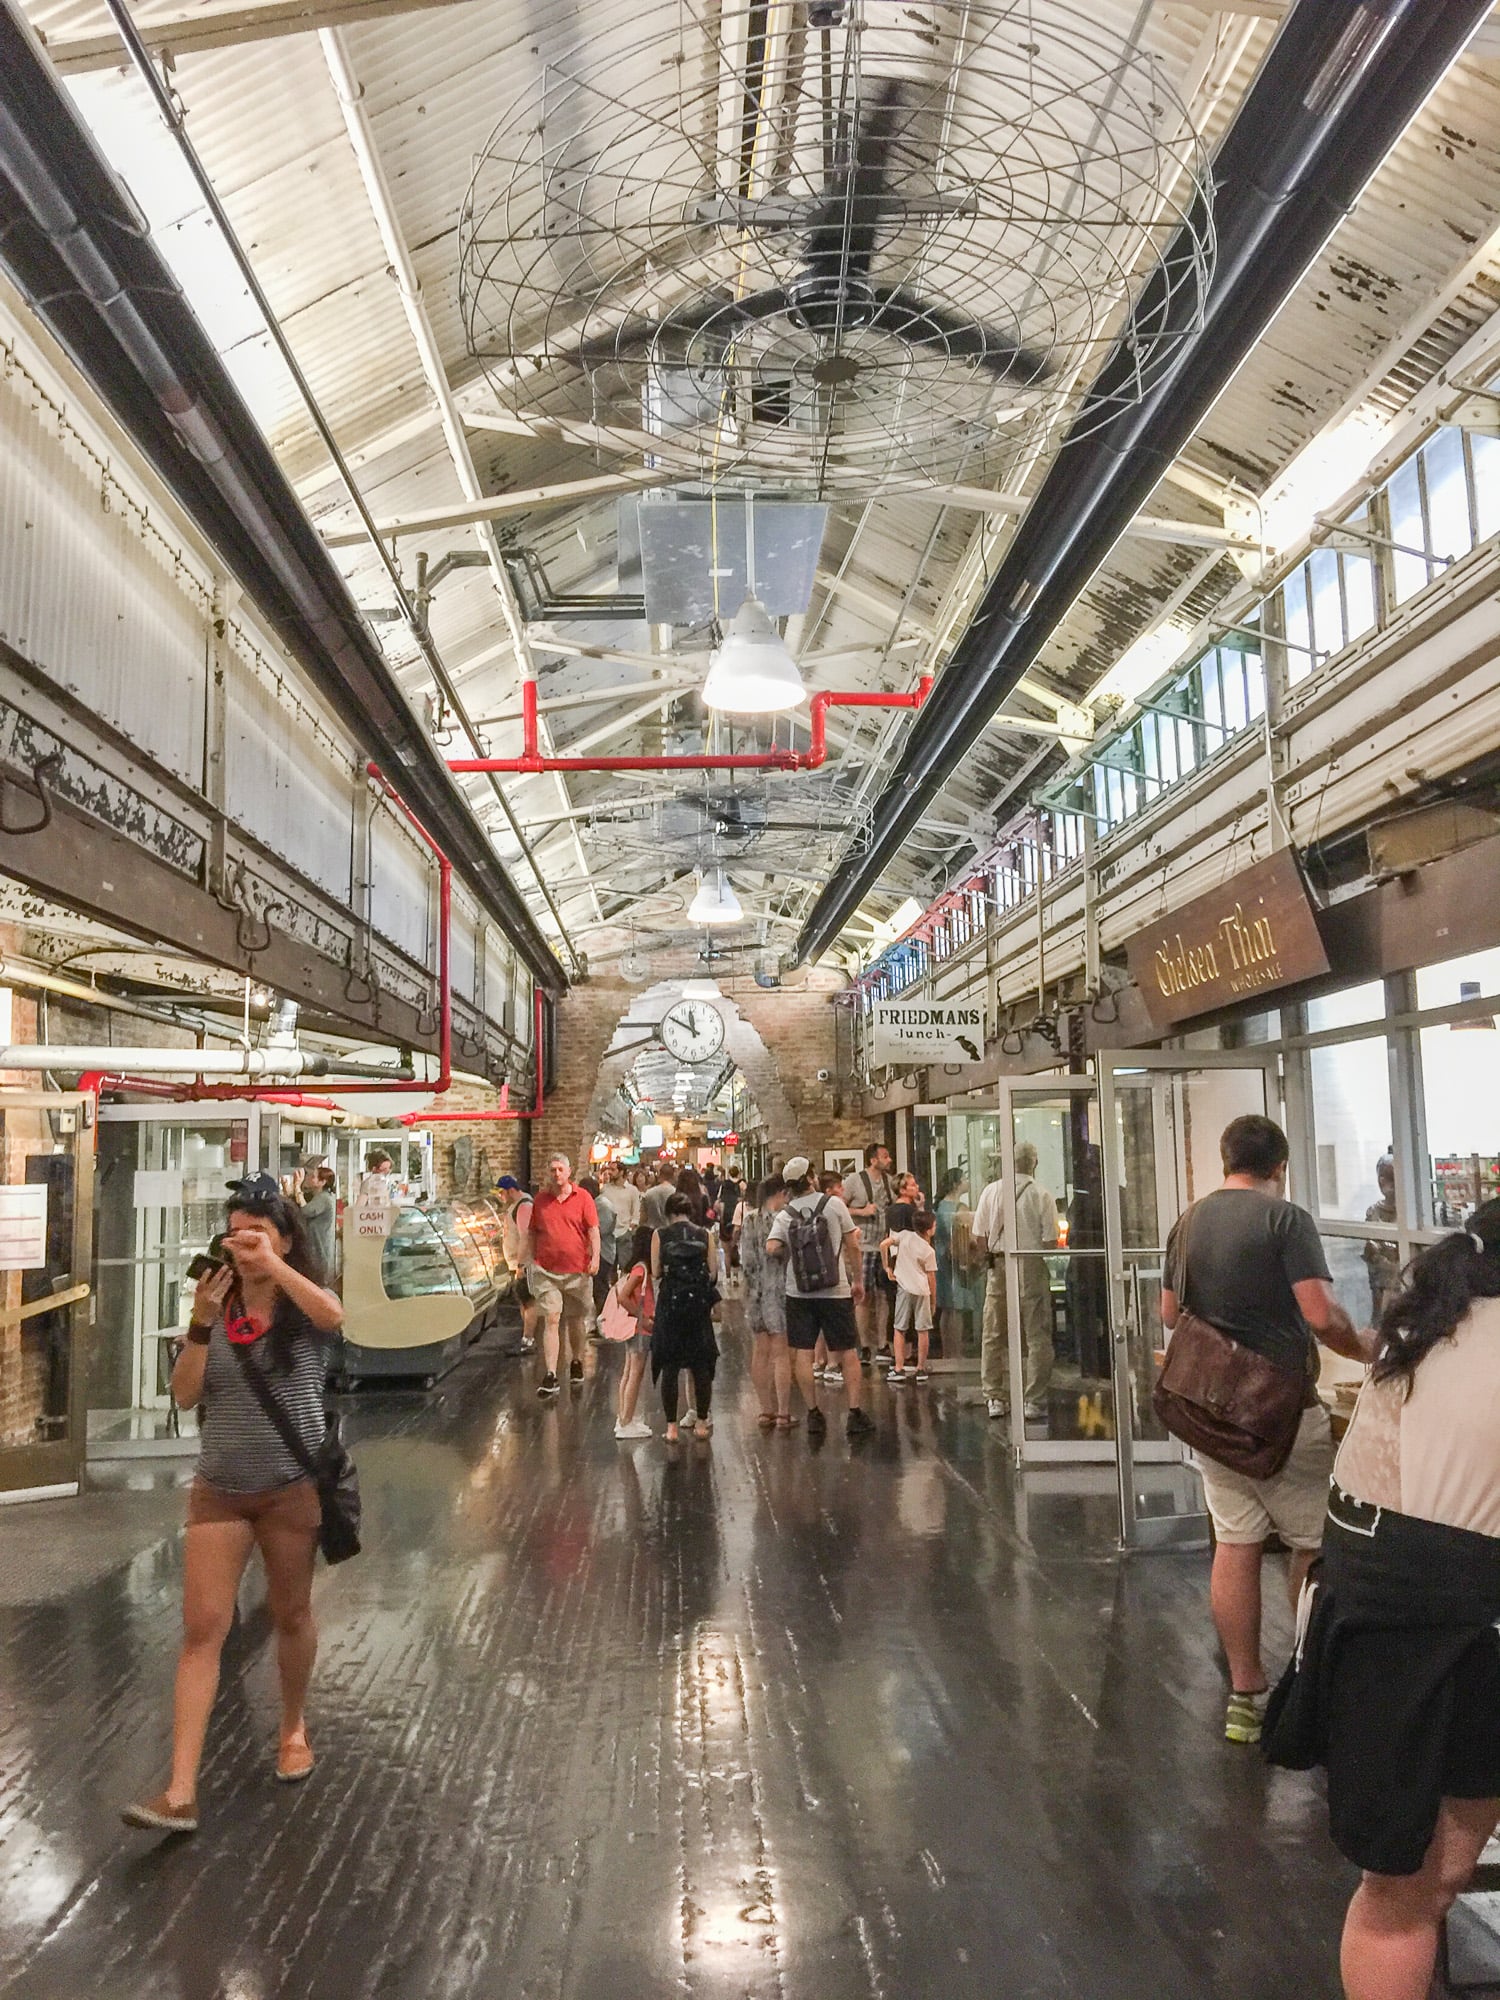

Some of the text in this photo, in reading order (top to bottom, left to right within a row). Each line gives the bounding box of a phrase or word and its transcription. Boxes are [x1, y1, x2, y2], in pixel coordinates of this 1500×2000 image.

[1155, 896, 1277, 997] Chelsea Thai
[709, 1015, 715, 1023] 2
[879, 1008, 980, 1025] FRIEDMANS
[668, 1027, 675, 1035] 9
[713, 1026, 719, 1035] 3
[672, 1039, 678, 1048] 8
[709, 1038, 716, 1046] 4
[682, 1045, 688, 1055] 7
[700, 1045, 706, 1054] 5
[690, 1049, 697, 1060] 6
[359, 1211, 384, 1221] CASH
[359, 1225, 383, 1235] ONLY
